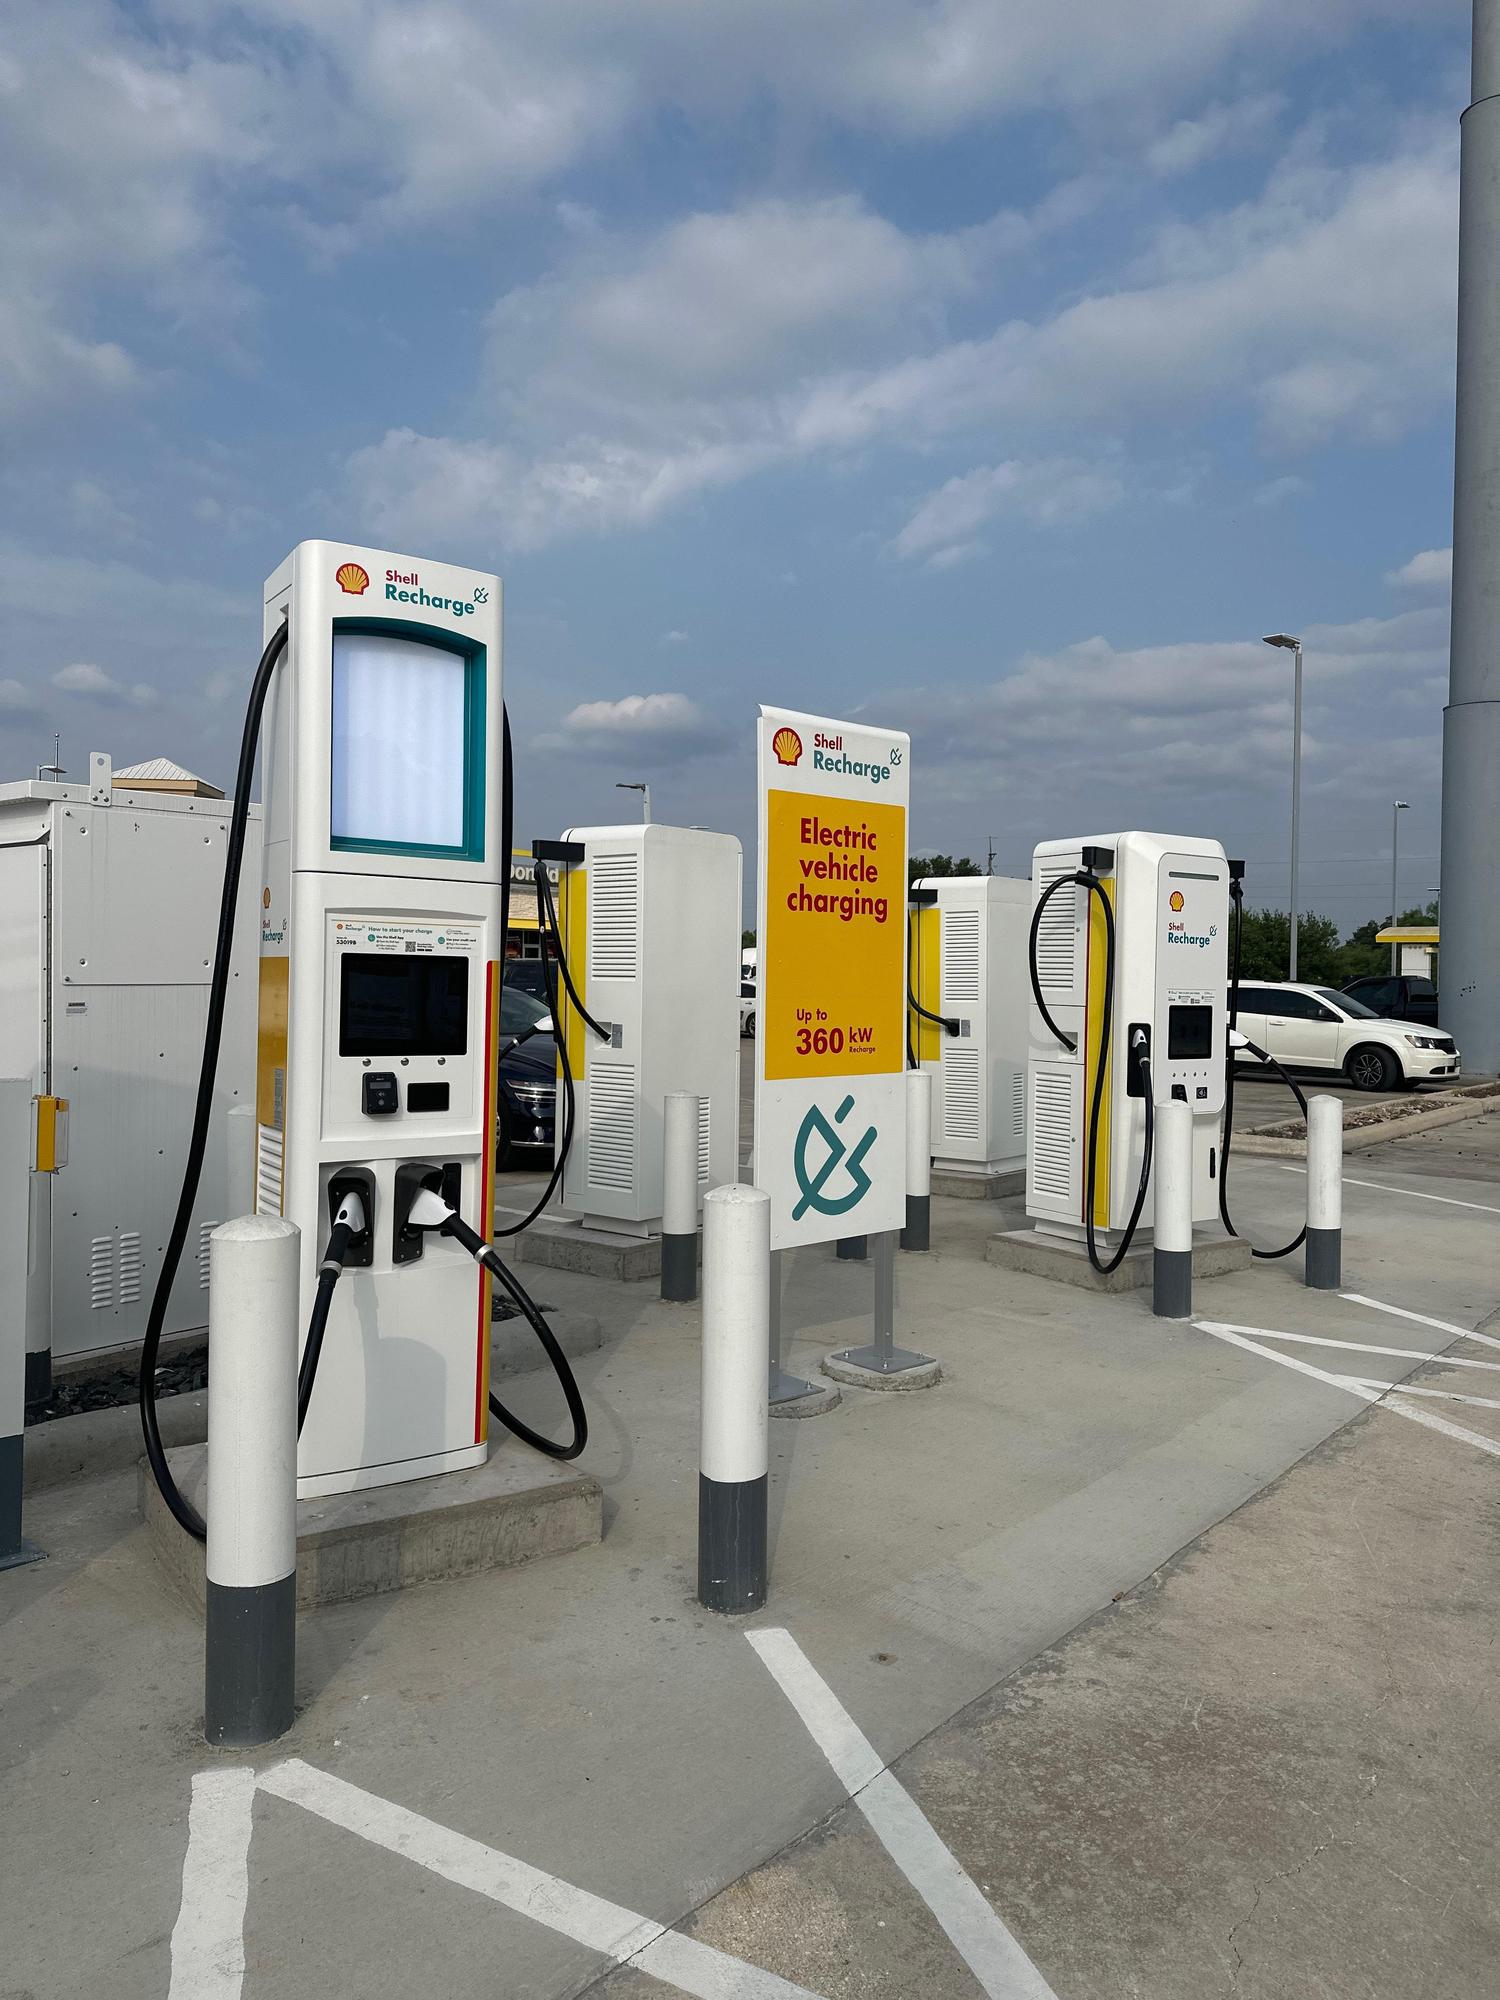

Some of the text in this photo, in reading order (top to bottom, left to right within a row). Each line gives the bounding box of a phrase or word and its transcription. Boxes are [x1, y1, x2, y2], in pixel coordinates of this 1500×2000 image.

[386, 570, 418, 586] Shell
[386, 584, 475, 617] Recharge
[814, 733, 842, 751] Shell
[814, 750, 890, 784] Recharge
[800, 816, 877, 850] Electric
[800, 852, 878, 882] vehicle
[787, 884, 888, 923] charging
[1168, 922, 1184, 931] Shell
[1168, 932, 1210, 948] Recharge
[796, 1008, 828, 1024] Up to
[796, 1026, 873, 1055] 360 kW
[849, 1046, 876, 1054] Recharge
